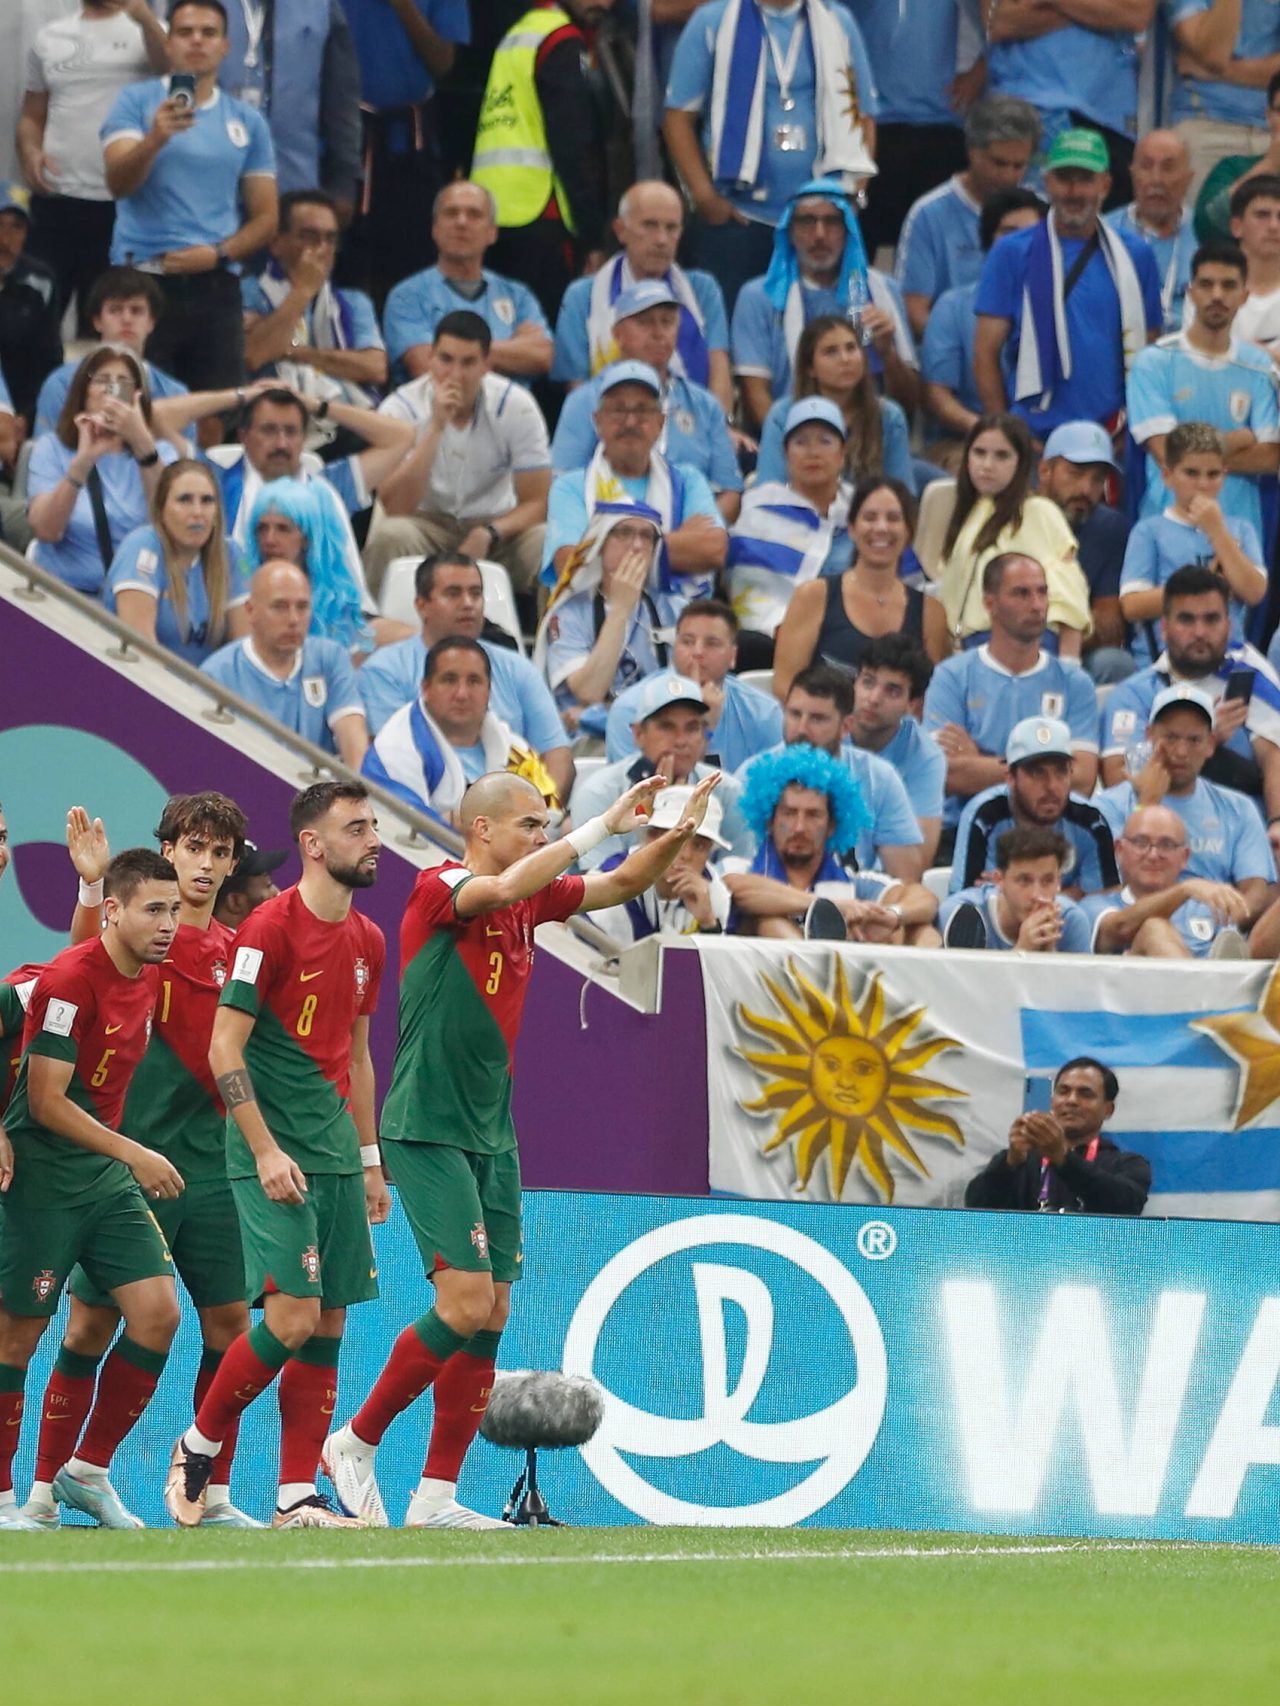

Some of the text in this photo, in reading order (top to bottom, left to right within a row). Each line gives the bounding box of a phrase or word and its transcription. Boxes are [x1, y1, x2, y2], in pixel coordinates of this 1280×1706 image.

[486, 951, 503, 995] 3
[296, 994, 318, 1036] 8
[91, 1049, 116, 1087] 5
